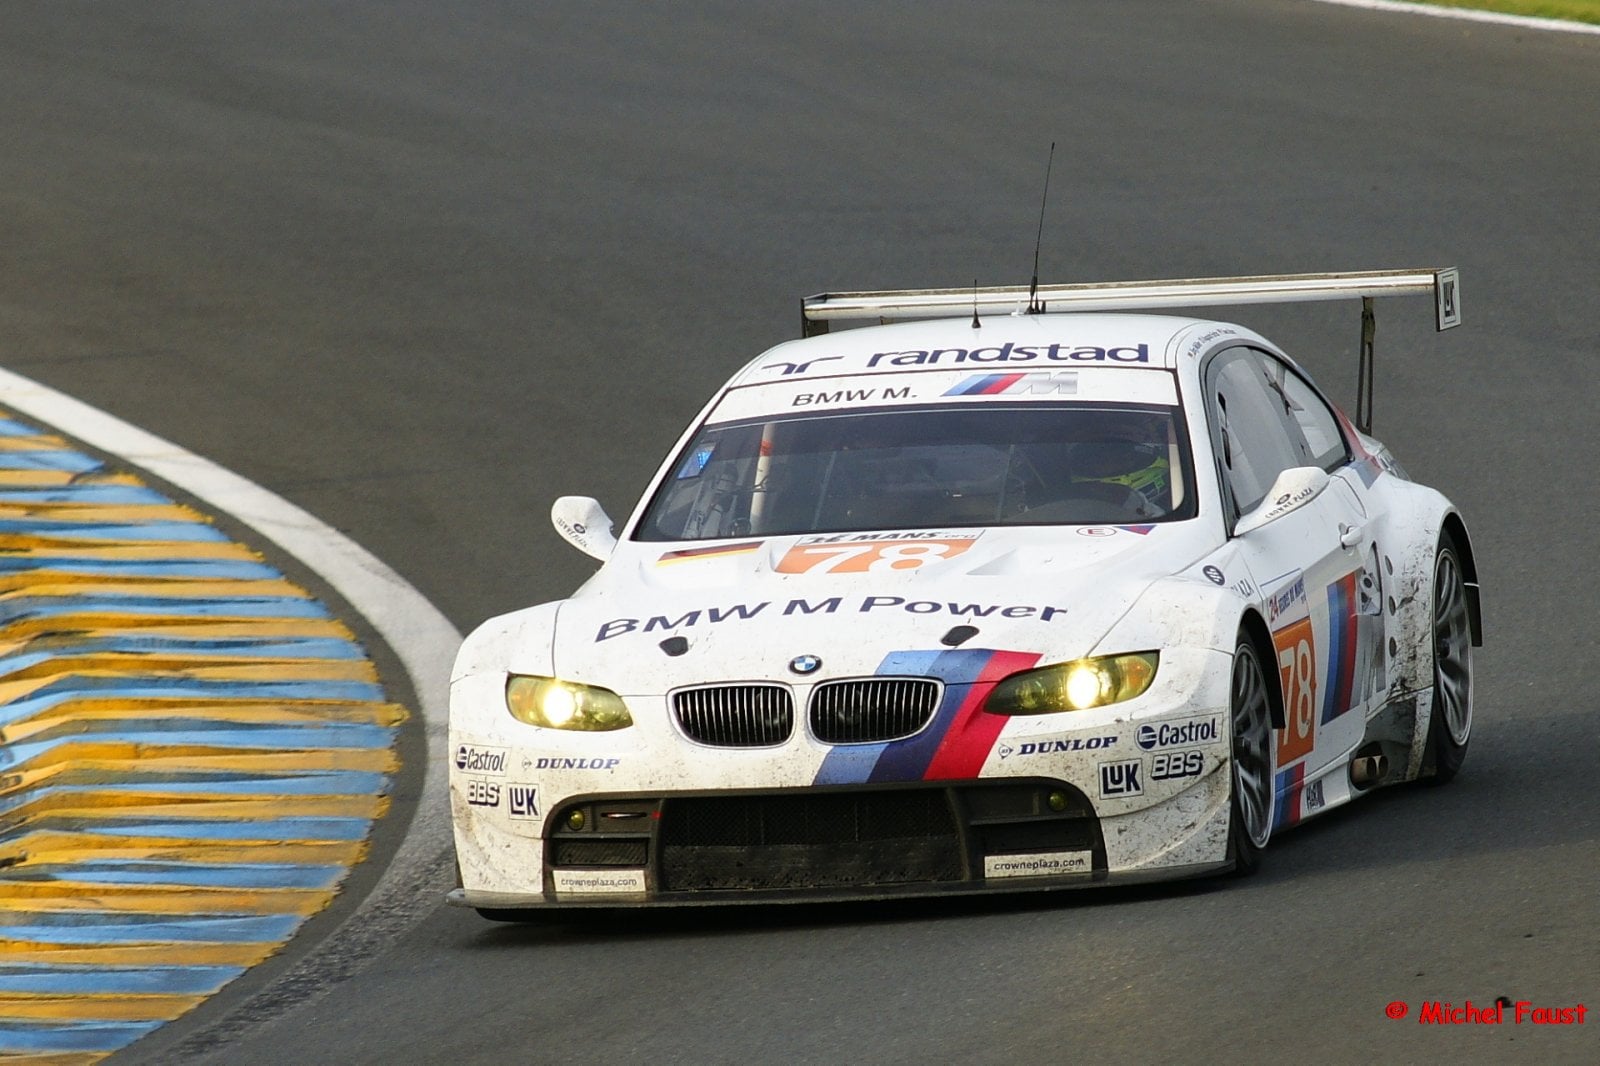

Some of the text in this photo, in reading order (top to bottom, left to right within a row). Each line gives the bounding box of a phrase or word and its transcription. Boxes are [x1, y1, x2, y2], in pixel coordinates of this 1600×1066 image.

[868, 342, 1148, 368] randstad
[793, 388, 875, 407] BMW
[803, 543, 951, 574] 78
[594, 596, 1069, 642] BMW M Power
[1279, 639, 1313, 746] 78
[1018, 736, 1118, 755] DUNLOP
[1158, 719, 1217, 747] Castrol
[467, 748, 506, 772] Castrol
[535, 757, 620, 770] DUNLOP
[1151, 750, 1204, 781] BBS
[468, 780, 500, 807] BBS
[994, 857, 1085, 872] crowneplaza.com
[561, 877, 637, 888] crowneplaza.com
